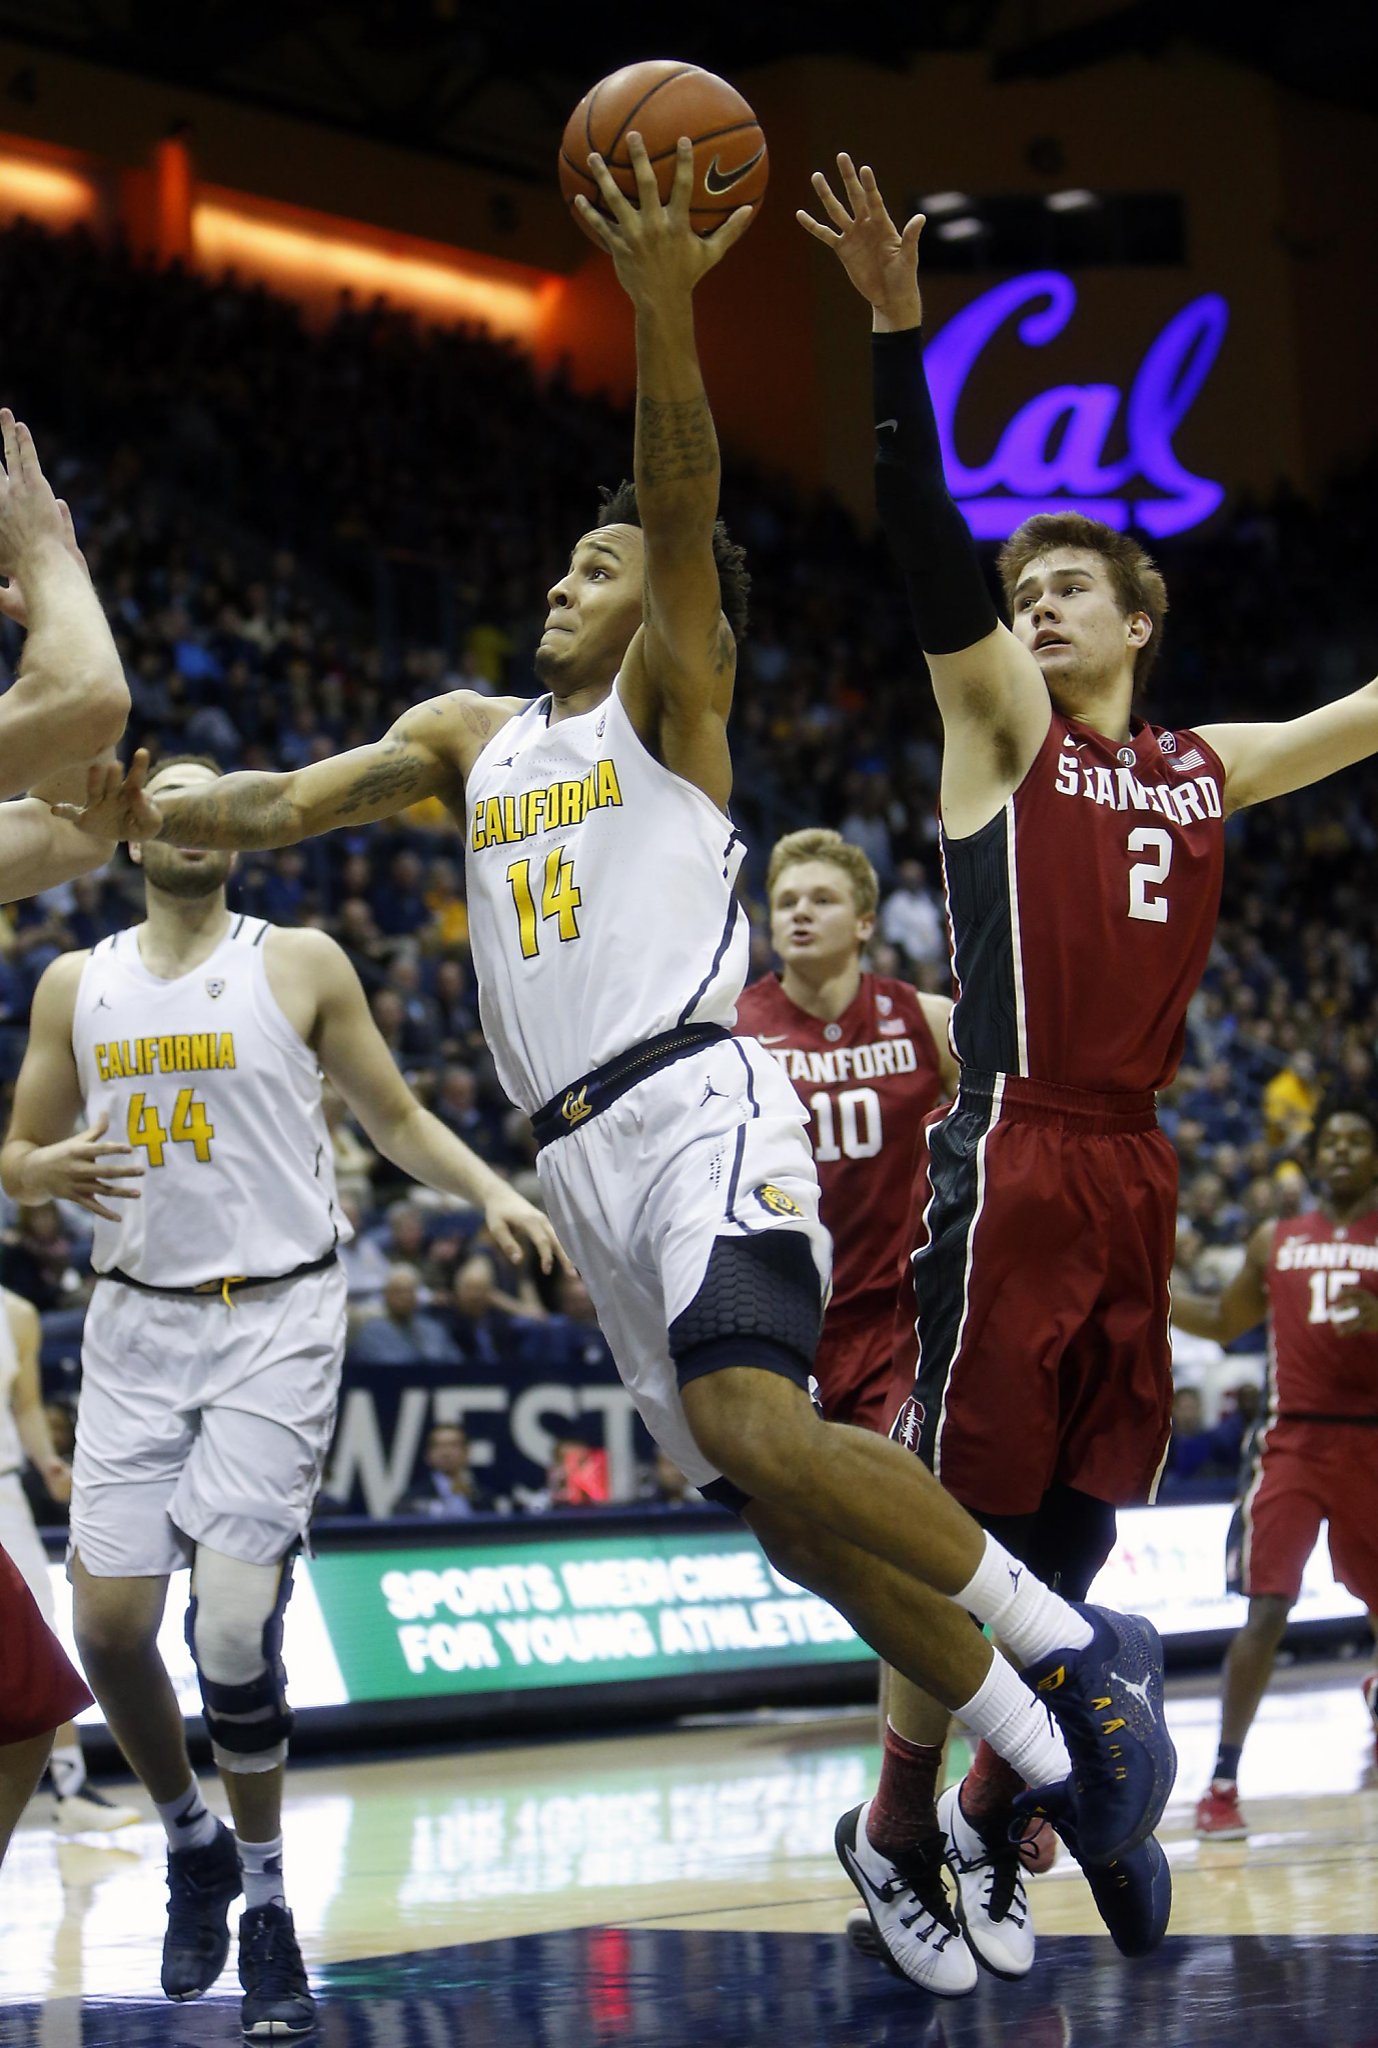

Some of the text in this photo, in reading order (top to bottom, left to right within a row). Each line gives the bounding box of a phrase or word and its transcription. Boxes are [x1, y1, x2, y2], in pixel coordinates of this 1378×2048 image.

[923, 269, 1230, 541] Cal
[1055, 752, 1222, 826] STANFORD
[506, 845, 582, 960] 14
[1127, 827, 1173, 924] 2
[95, 1032, 236, 1081] CALIFORNIA
[768, 1038, 918, 1083] TANFORD
[127, 1087, 215, 1168] 44
[561, 1084, 593, 1127] Cal
[810, 1087, 883, 1163] 10
[1276, 1242, 1378, 1271] STANFOR
[1307, 1270, 1362, 1324] 15
[322, 1384, 637, 1521] WEST
[380, 1564, 561, 1620] SPORTS
[560, 1551, 772, 1608] MEDICINE
[397, 1622, 500, 1674] FOR
[496, 1610, 657, 1666] YOUNG
